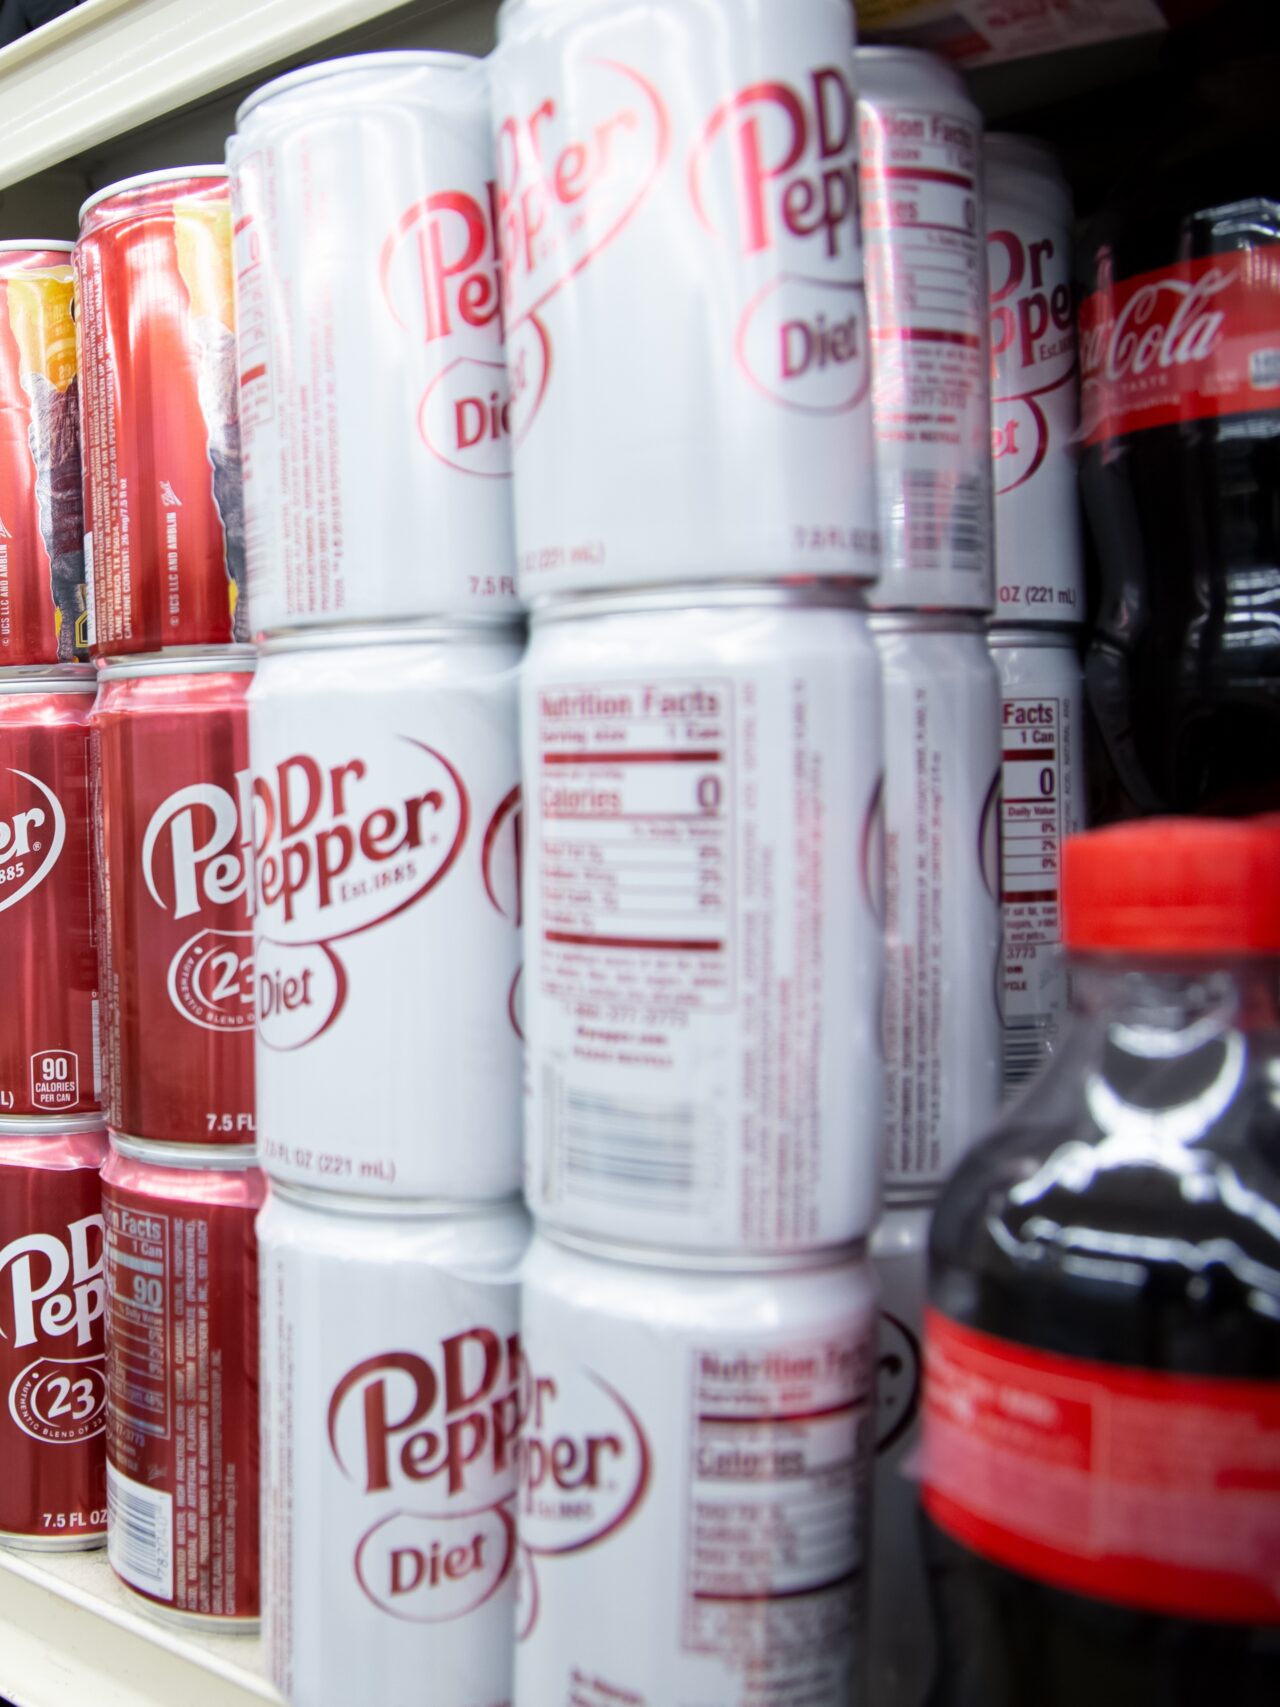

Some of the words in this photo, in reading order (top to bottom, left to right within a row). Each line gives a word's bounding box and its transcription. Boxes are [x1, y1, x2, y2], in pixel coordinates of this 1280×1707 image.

[779, 314, 858, 379] Diet
[0, 580, 8, 597] AND
[0, 600, 9, 616] LLC
[0, 618, 10, 634] UCS
[1003, 703, 1054, 725] Facts
[1021, 730, 1027, 744] 1
[1032, 730, 1056, 744] Can
[276, 754, 366, 836] Dr
[1040, 767, 1056, 797] 0
[339, 861, 417, 902] Est.1885
[259, 968, 315, 1020] Diet
[207, 1011, 244, 1025] BLEND
[42, 1057, 68, 1081] 90
[35, 1080, 76, 1095] CALORIES
[40, 1092, 54, 1103] PER
[55, 1092, 71, 1103] CAN
[206, 1114, 233, 1131] 7.5
[236, 1115, 256, 1131] FL
[318, 1151, 353, 1176] (221
[359, 1160, 397, 1183] mL)
[121, 1208, 162, 1240] Facts
[140, 1240, 163, 1258] Can
[132, 1275, 164, 1308] 90
[18, 1380, 40, 1430] AUTHENTIC
[42, 1428, 76, 1439] BLEND
[78, 1424, 91, 1436] OF
[46, 1376, 96, 1420] 23
[327, 1350, 524, 1498] Pepp
[44, 1513, 66, 1528] 7.5
[70, 1512, 87, 1528] FL
[90, 1510, 108, 1526] OZ
[390, 1534, 486, 1597] Diet
